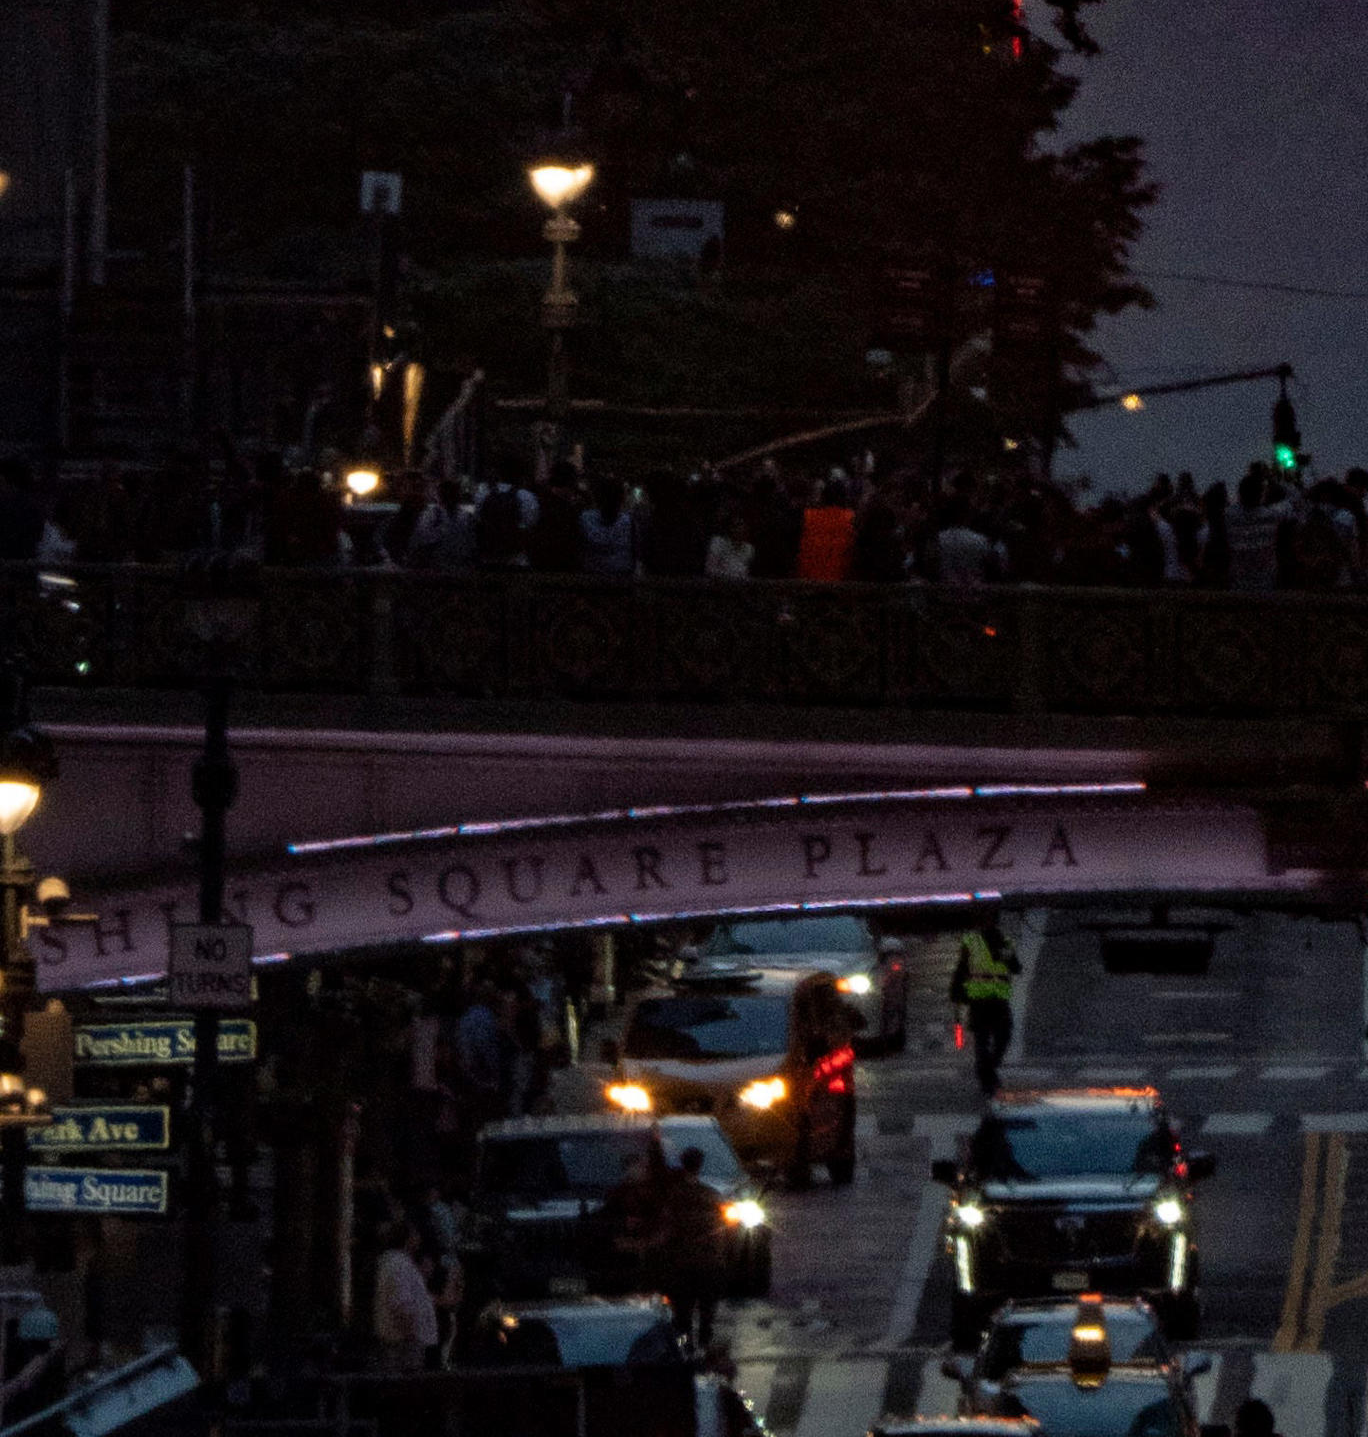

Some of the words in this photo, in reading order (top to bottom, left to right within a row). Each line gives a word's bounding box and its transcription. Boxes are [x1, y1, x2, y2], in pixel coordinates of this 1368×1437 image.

[385, 841, 730, 919] SQUARE
[803, 825, 1081, 878] PLAZA
[194, 938, 227, 962] NO
[175, 973, 247, 994] TURNS
[75, 1029, 172, 1058] Pershing
[88, 1116, 139, 1141] Ave
[81, 1174, 162, 1206] Square
